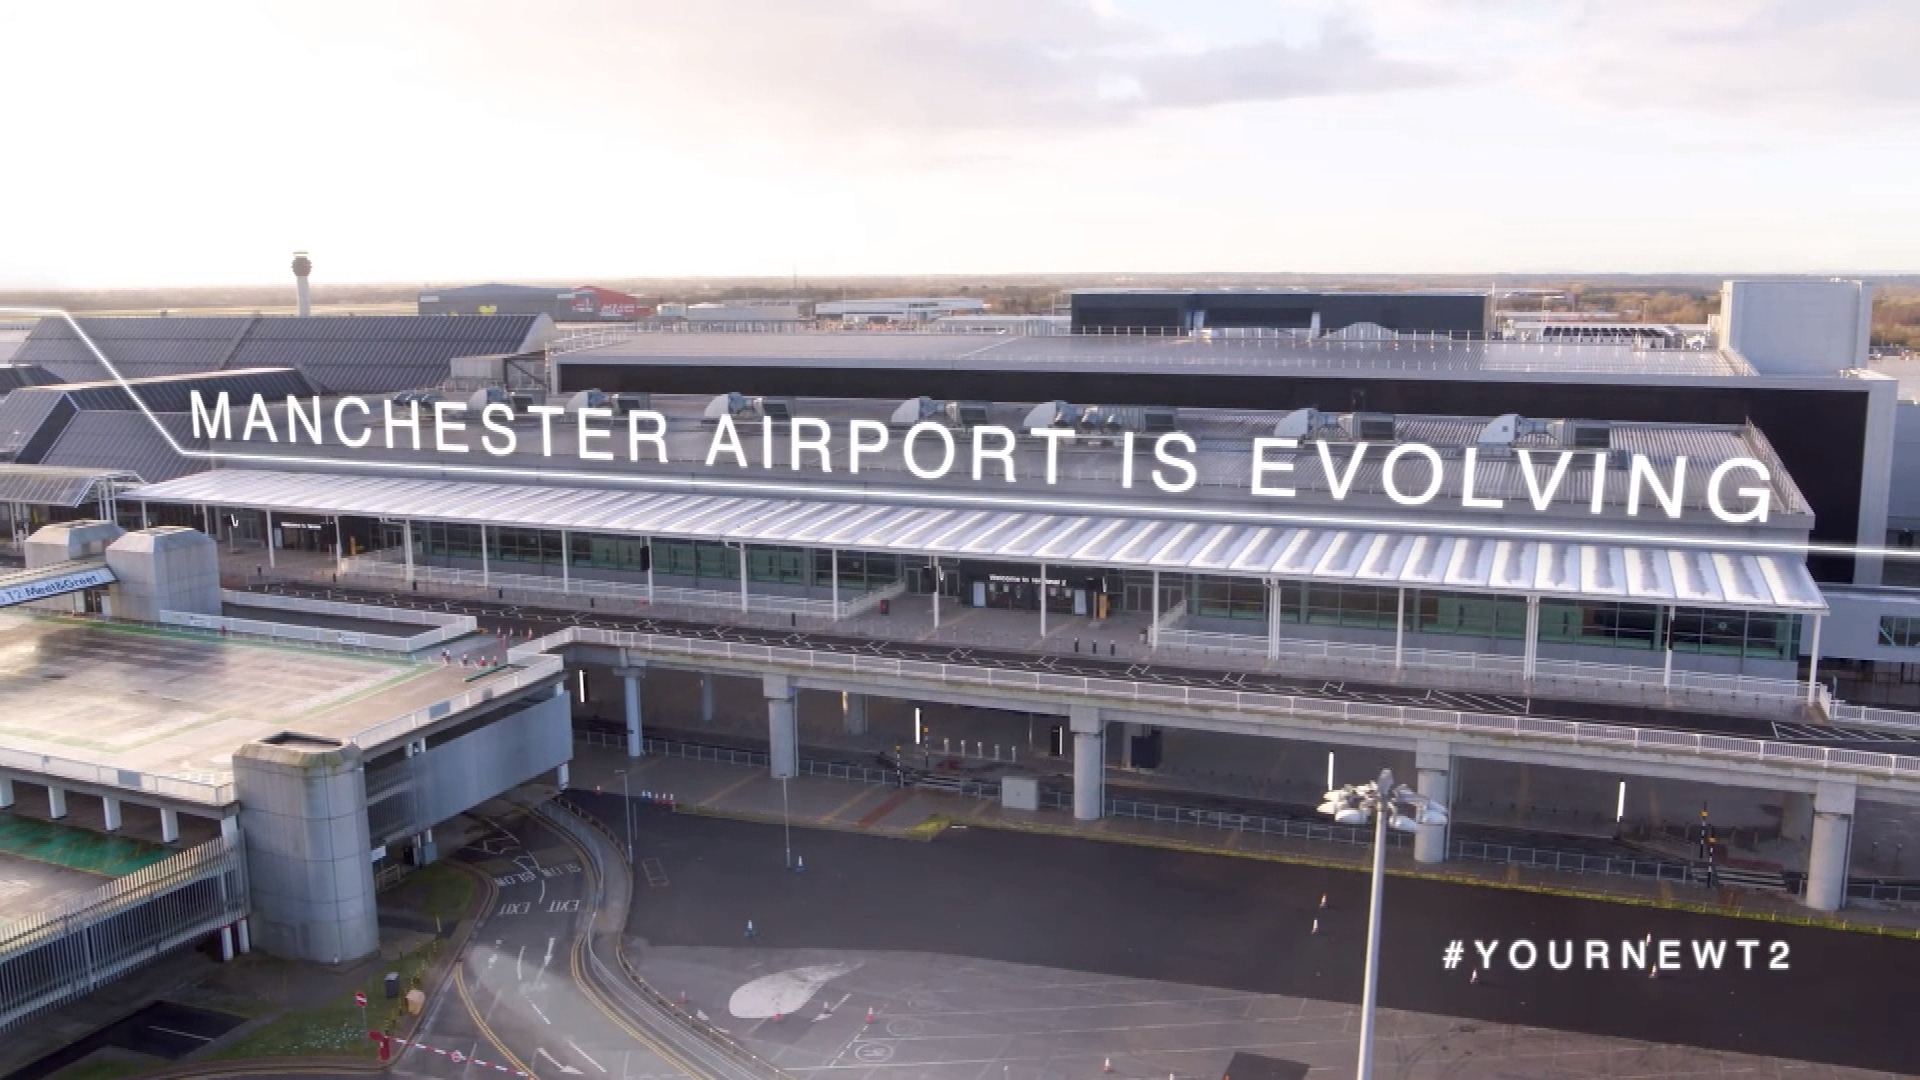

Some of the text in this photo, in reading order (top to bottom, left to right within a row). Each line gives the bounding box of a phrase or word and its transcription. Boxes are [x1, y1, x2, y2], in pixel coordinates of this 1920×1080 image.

[6, 590, 23, 601] T2
[25, 575, 98, 597] Meet&Greet
[497, 902, 531, 917] EXIT
[546, 900, 580, 913] EXIT
